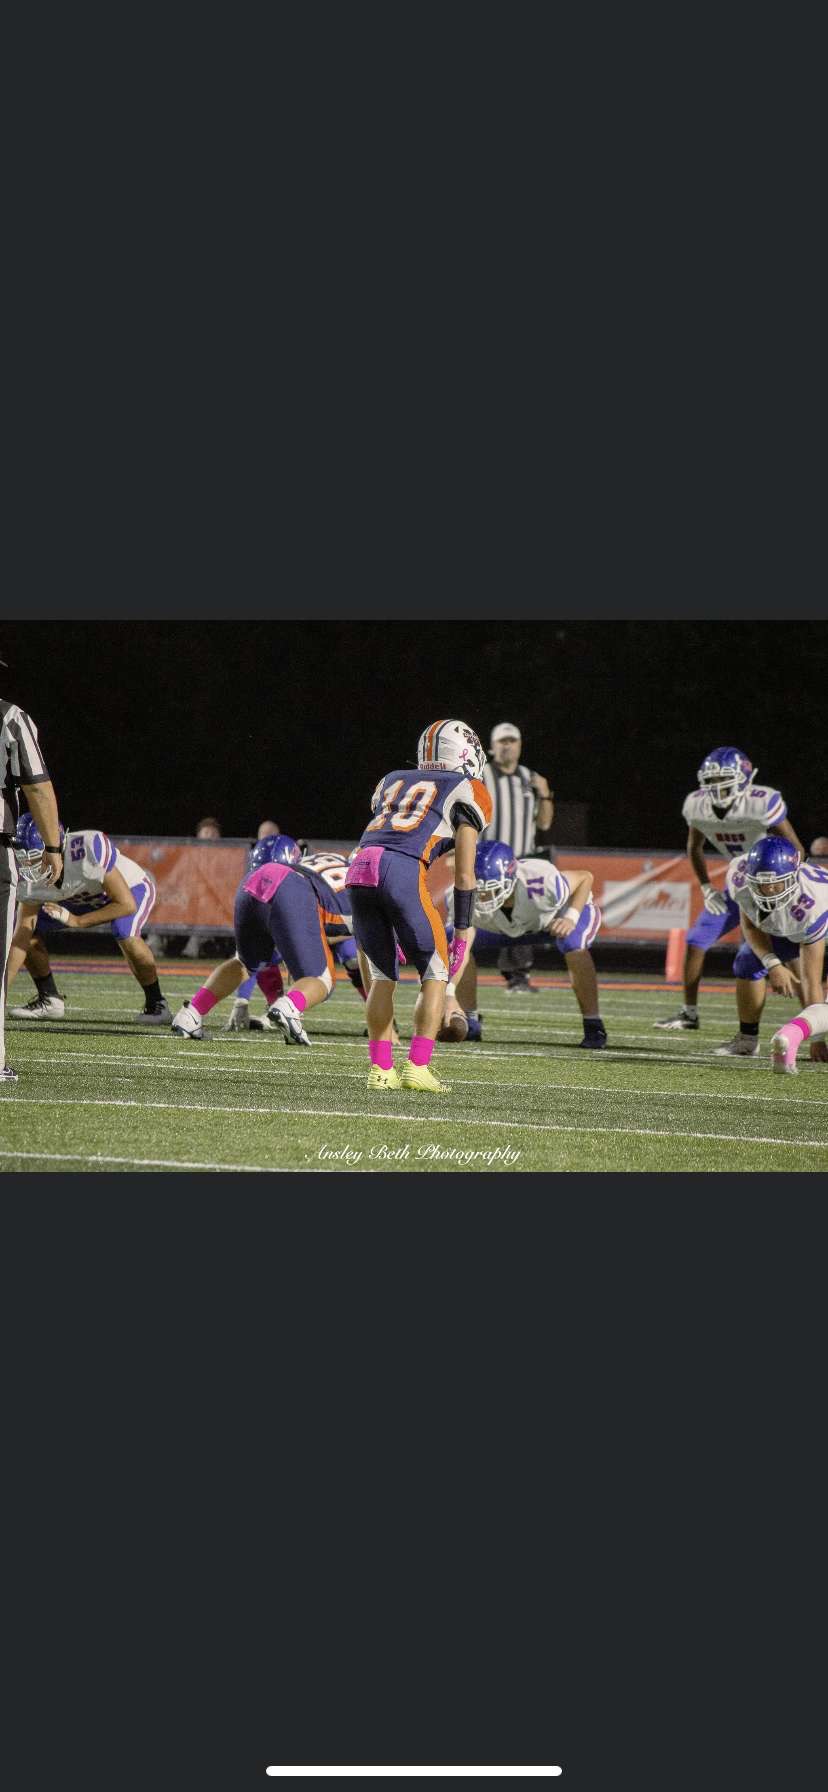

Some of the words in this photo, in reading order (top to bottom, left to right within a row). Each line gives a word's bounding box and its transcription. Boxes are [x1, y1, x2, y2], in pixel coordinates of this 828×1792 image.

[367, 779, 438, 832] 10
[70, 834, 86, 862] 53
[526, 876, 545, 899] 71
[790, 893, 815, 922] 63
